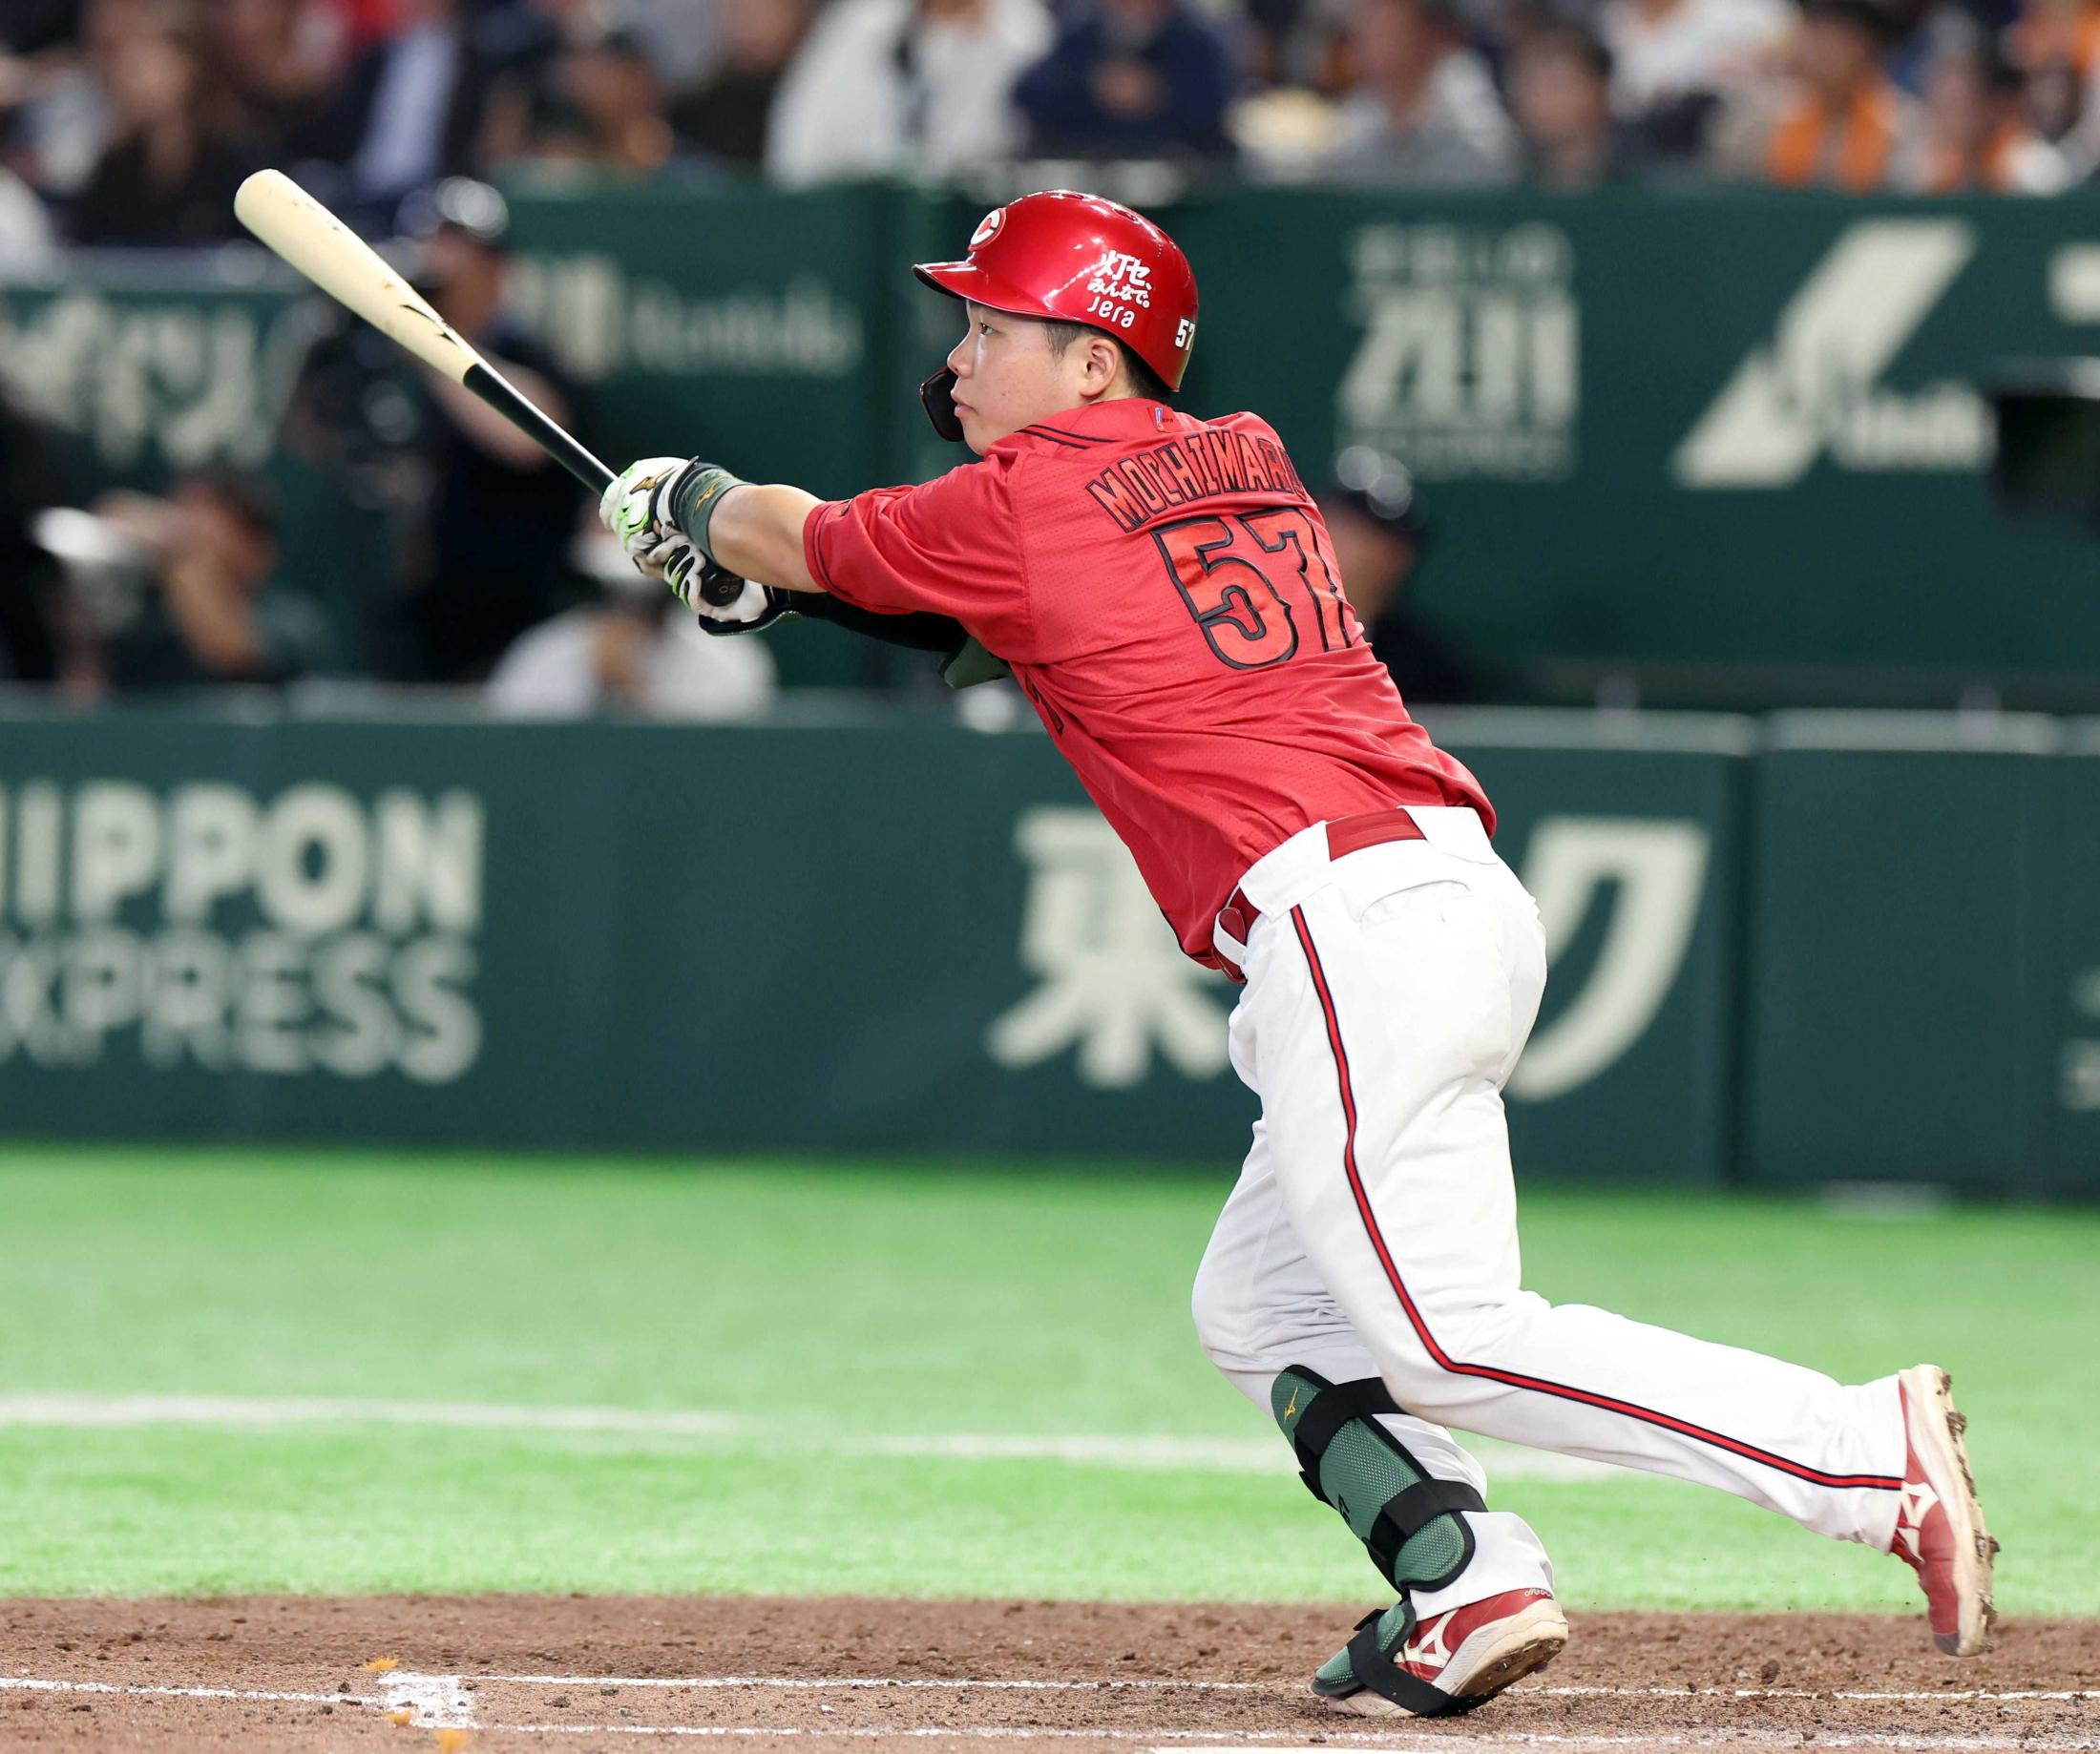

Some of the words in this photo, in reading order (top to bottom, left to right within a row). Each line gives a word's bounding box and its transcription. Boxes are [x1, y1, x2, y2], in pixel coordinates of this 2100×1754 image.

[1087, 278, 1150, 308] みんなで。
[1149, 507, 1352, 670] 57
[0, 780, 485, 934] IPPON
